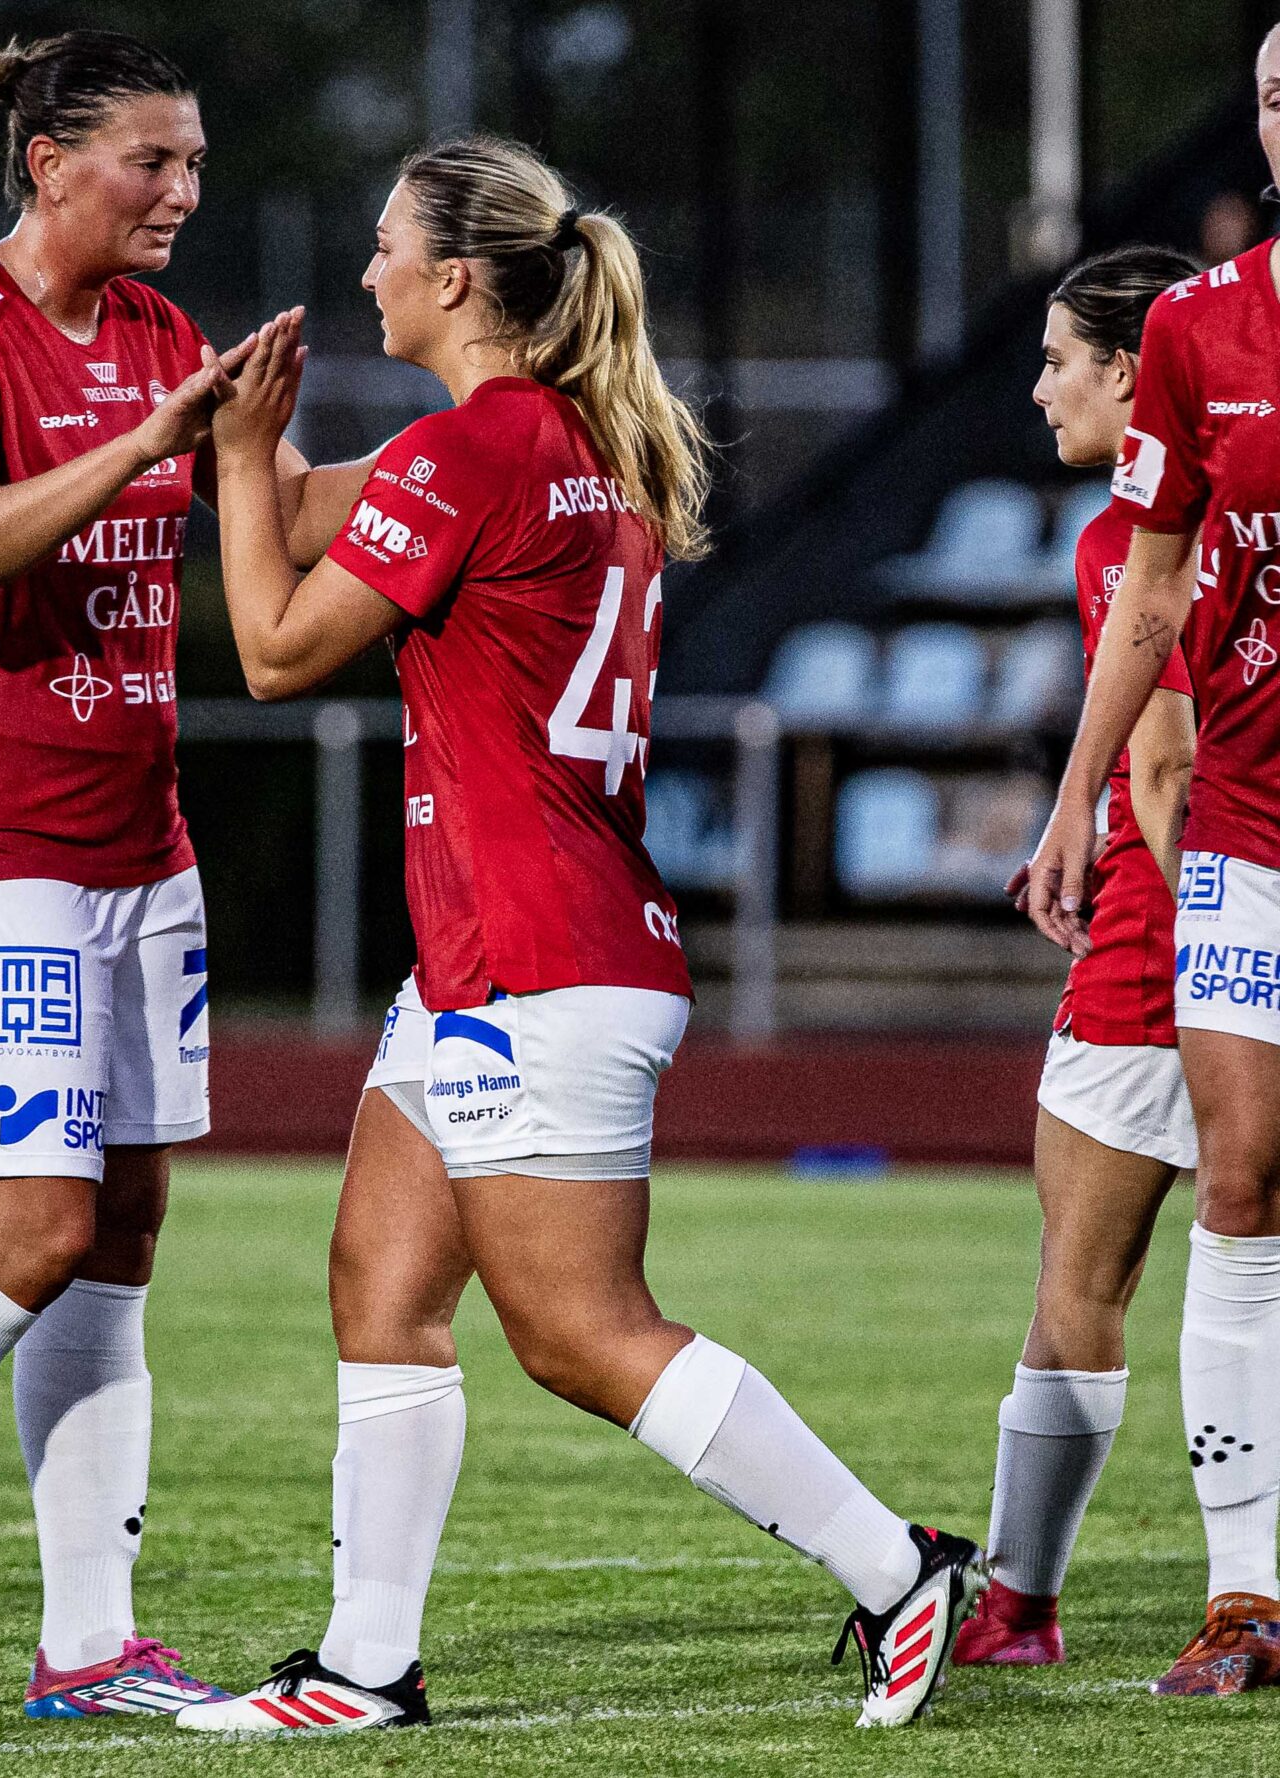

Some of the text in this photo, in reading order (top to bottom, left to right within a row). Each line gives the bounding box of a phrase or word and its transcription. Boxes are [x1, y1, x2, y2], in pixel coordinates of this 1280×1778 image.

[1207, 401, 1260, 415] CRAFT
[39, 414, 87, 429] CRAFT
[351, 500, 412, 555] MVB
[1195, 943, 1280, 980] INTE
[477, 1074, 521, 1092] Hamn
[448, 1107, 497, 1124] CRAFT
